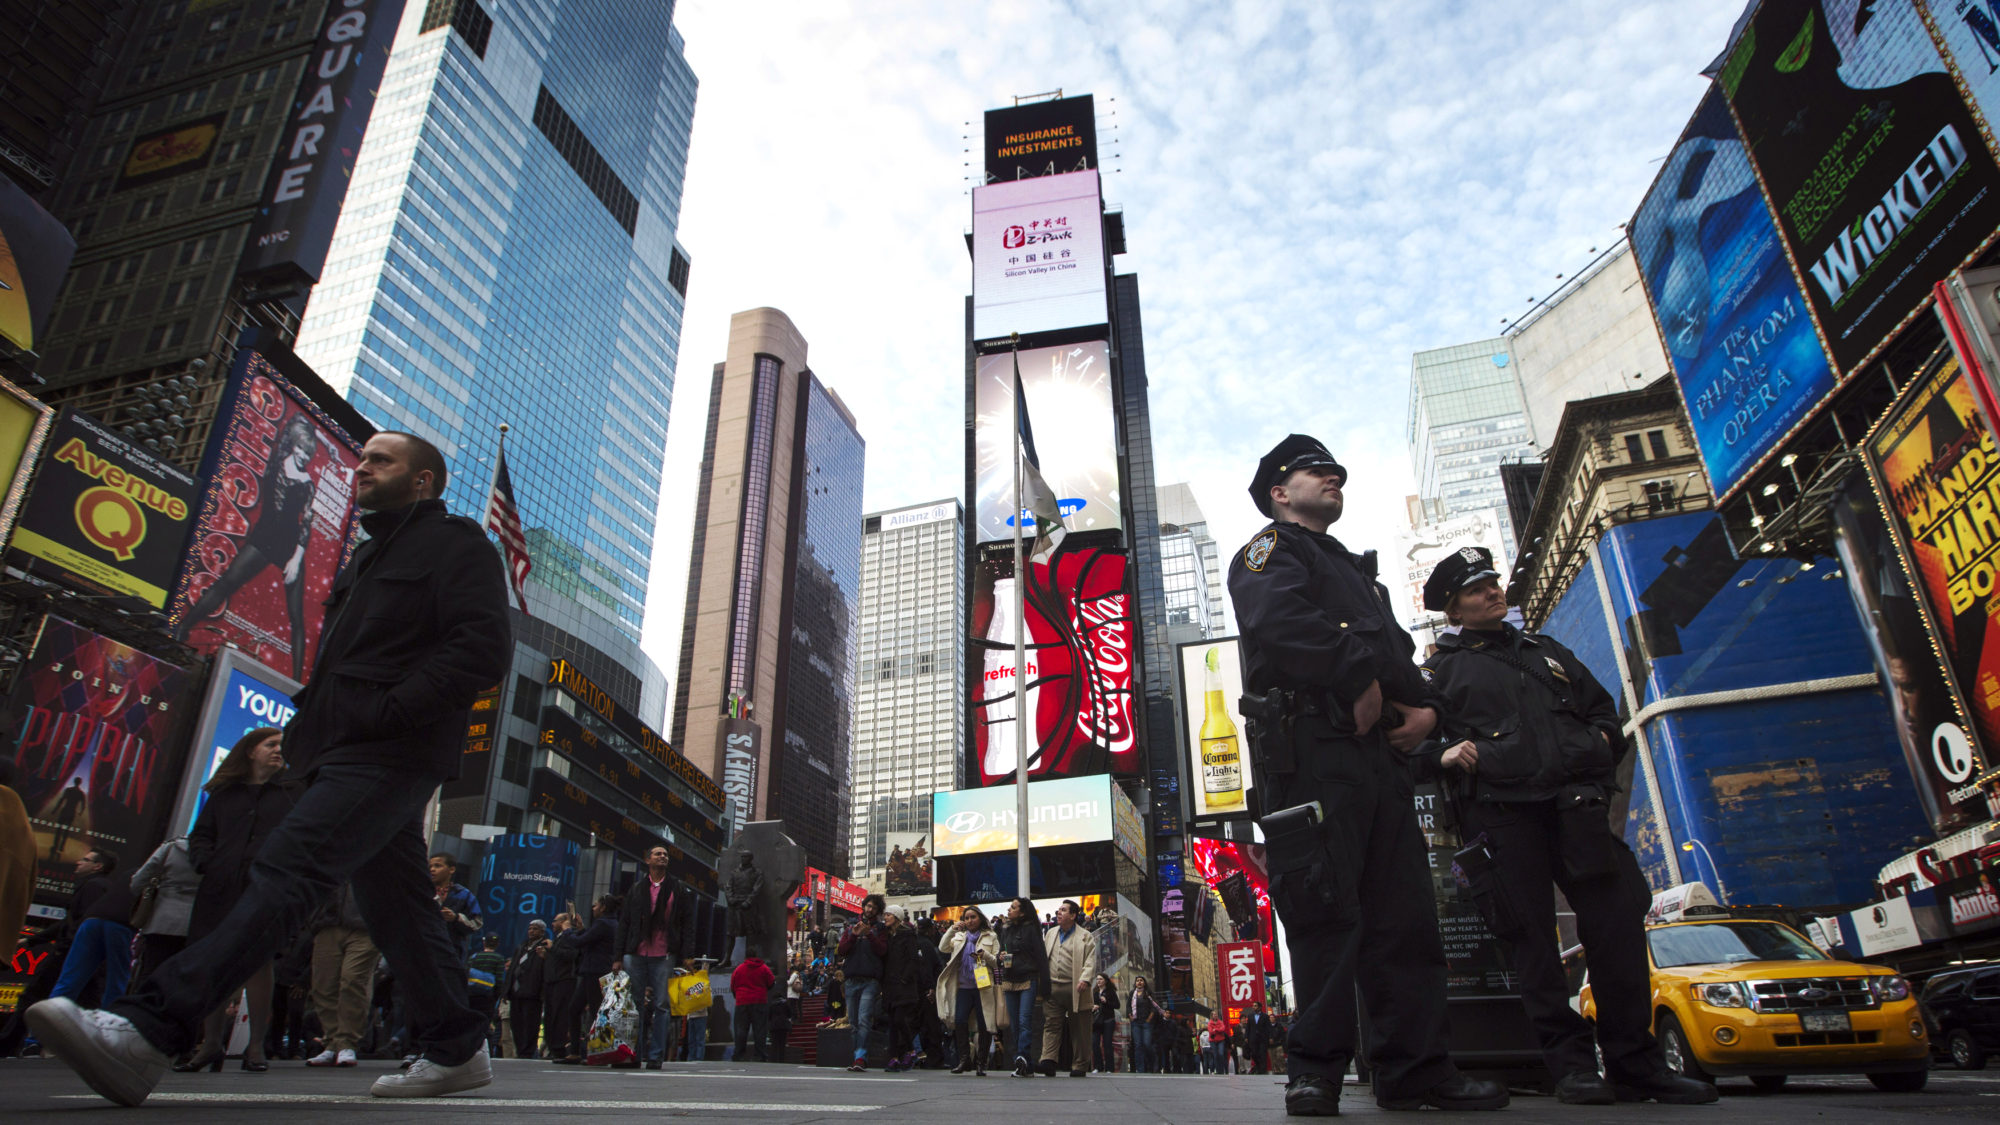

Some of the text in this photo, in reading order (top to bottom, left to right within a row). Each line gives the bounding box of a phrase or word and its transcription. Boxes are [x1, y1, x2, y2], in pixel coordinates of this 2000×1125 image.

[273, 0, 367, 204] QUARE
[998, 136, 1083, 158] INVESTMENTS
[1005, 124, 1075, 145] INSURANCE
[1792, 155, 1845, 229] BIGGEST
[258, 229, 291, 247] NYC
[1008, 249, 1071, 265] 中国硅谷
[1028, 267, 1048, 275] Valley
[1696, 295, 1797, 421] PHANTOM
[1719, 324, 1747, 356] The
[1722, 369, 1793, 446] OPERA
[96, 437, 124, 456] BEST
[53, 436, 190, 522] Avenue
[188, 375, 287, 619] CHICAGO
[1906, 431, 1999, 539] HANDS
[74, 485, 148, 562] Q
[889, 511, 930, 527] Allianz
[1948, 549, 2000, 616] BO
[52, 662, 170, 712] JOIN US
[13, 704, 158, 816] PIPPIN
[1203, 752, 1237, 766] Corona
[1211, 766, 1233, 777] Light
[723, 733, 754, 831] HERSHEY'S
[992, 800, 1099, 828] HYUNDAI
[503, 872, 561, 886] Morgan Stanley
[1949, 886, 2000, 923] Annie
[1228, 947, 1256, 1002] tkts
